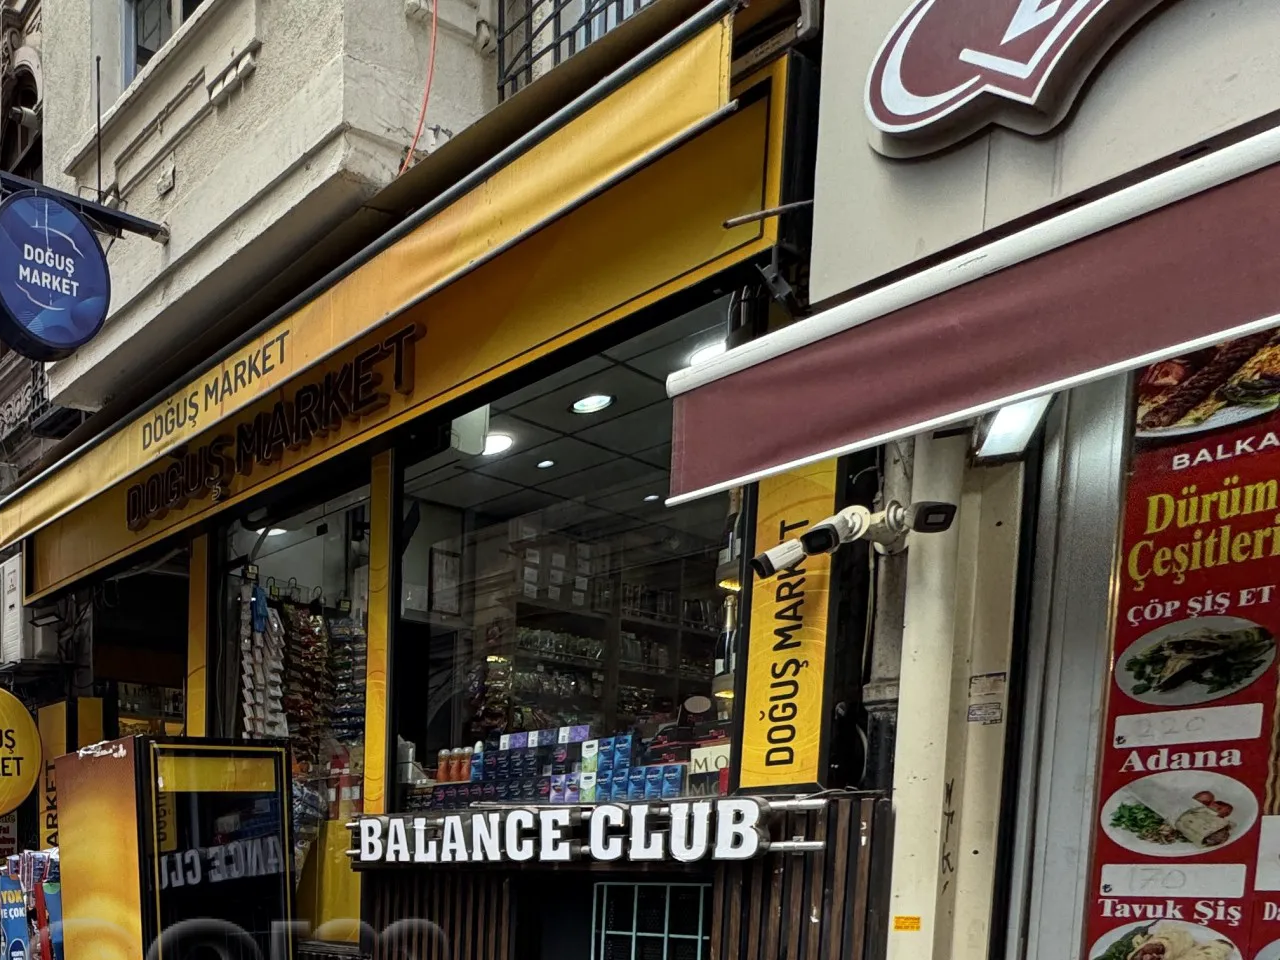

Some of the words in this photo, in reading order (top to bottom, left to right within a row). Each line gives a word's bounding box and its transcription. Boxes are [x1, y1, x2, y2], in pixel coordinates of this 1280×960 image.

[18, 264, 80, 297] MARKET
[23, 243, 75, 278] DOĞUŞ
[141, 390, 200, 450] DOĞUŞ
[203, 329, 290, 412] MARKET
[126, 434, 234, 531] DOĞUŞ
[234, 323, 423, 475] MARKET
[1143, 475, 1279, 535] Dürüm
[1127, 514, 1280, 592] Çeşitleri
[772, 519, 810, 651] MARKT
[1126, 598, 1181, 627] ÇÖP
[1186, 589, 1231, 618] ŞİŞ
[1237, 585, 1277, 607] ET
[758, 657, 810, 767] DOĞUŞ
[1118, 748, 1243, 773] Adana
[359, 808, 573, 863] BALANCE
[588, 798, 761, 863] CLUB
[1097, 898, 1185, 919] Tavuk
[1193, 900, 1242, 926] Şiş
